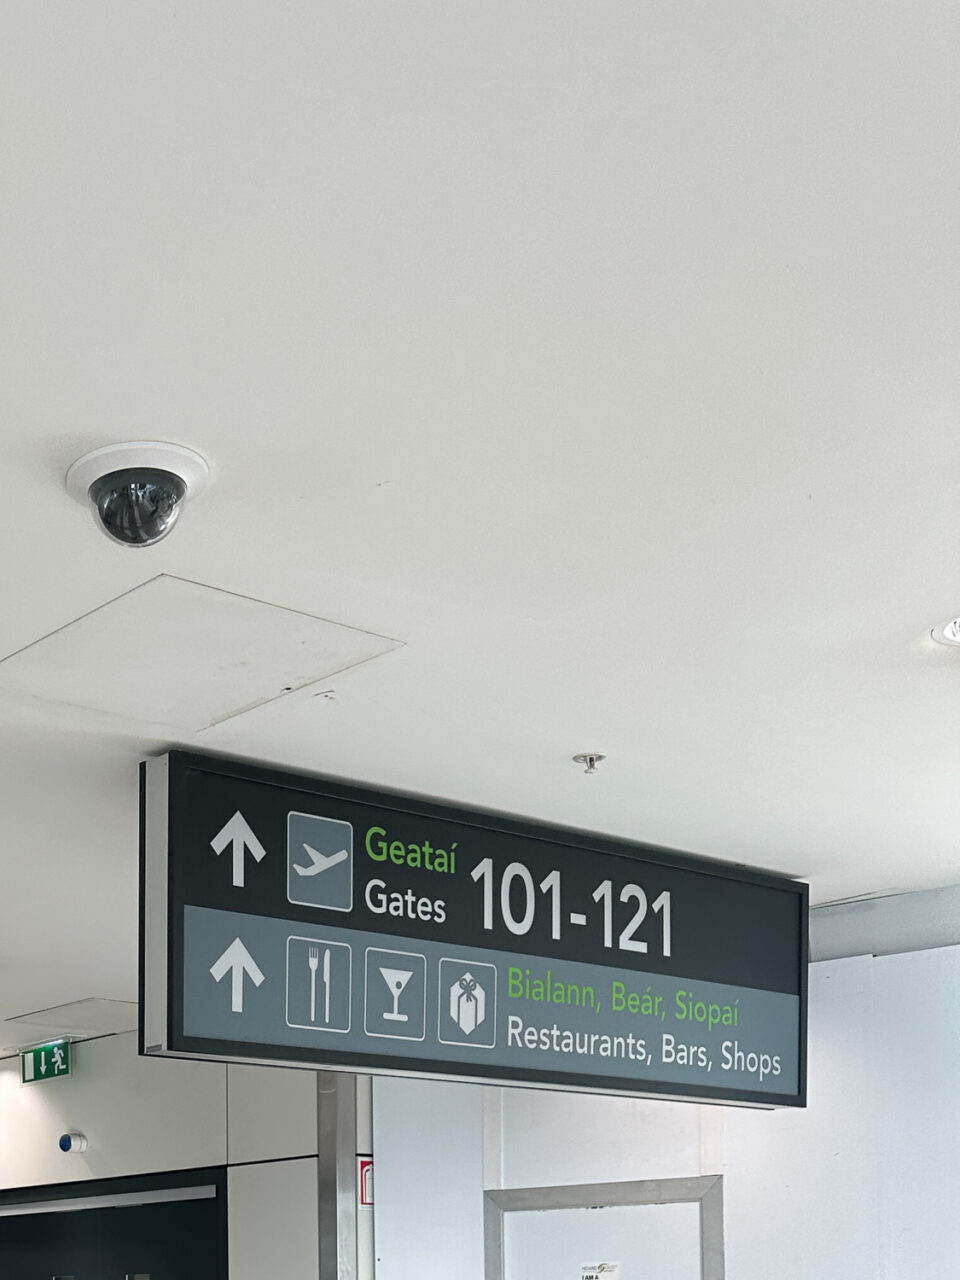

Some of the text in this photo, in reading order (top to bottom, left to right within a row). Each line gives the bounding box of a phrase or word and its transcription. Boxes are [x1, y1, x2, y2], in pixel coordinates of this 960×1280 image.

[365, 826, 458, 874] Geataí
[365, 878, 446, 923] Gates
[470, 857, 671, 957] 101-121
[508, 966, 739, 1031] Bialann, Beár, Siopaí
[507, 1015, 781, 1081] Restaurants, Bars, Shops
